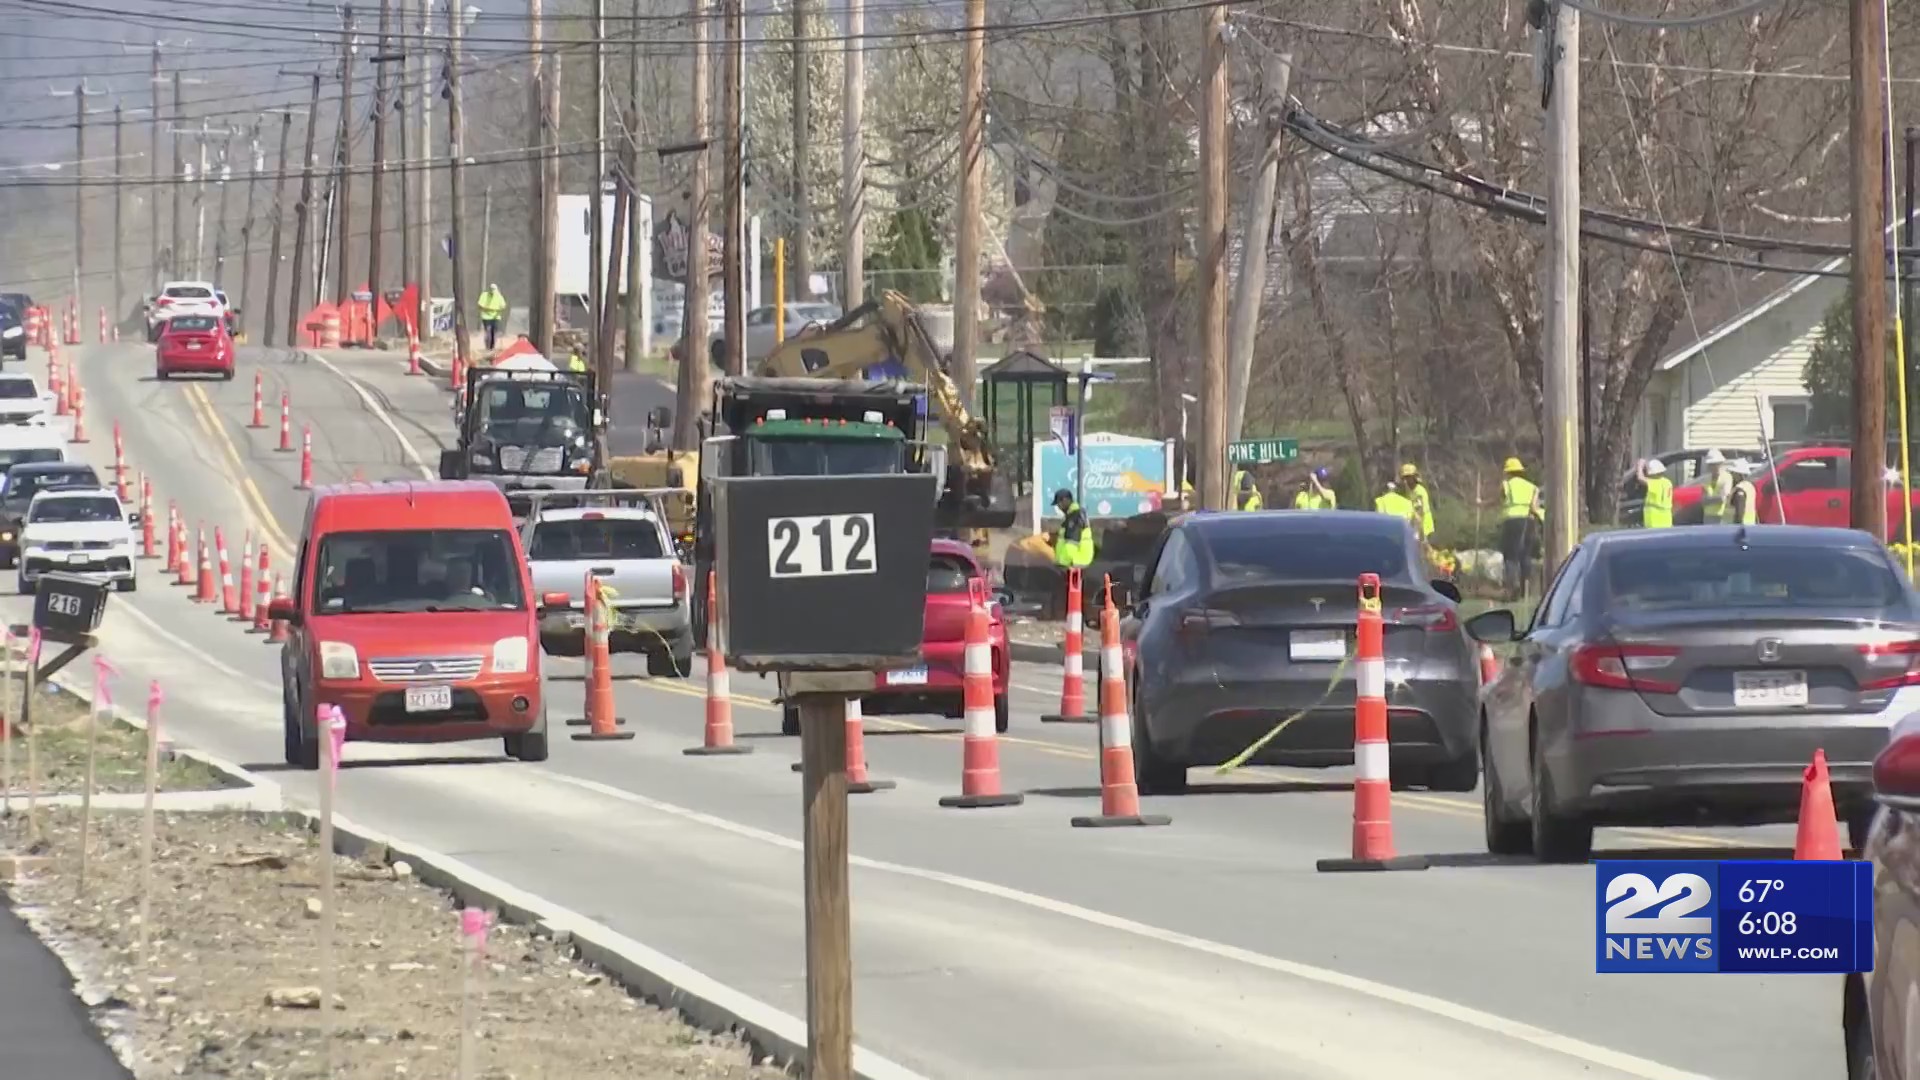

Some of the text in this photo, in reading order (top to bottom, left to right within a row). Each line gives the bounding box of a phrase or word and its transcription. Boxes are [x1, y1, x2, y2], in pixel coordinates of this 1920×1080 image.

[1228, 443, 1256, 461] PINE
[1260, 441, 1286, 459] HILL
[773, 515, 872, 574] 212
[50, 595, 79, 614] 216
